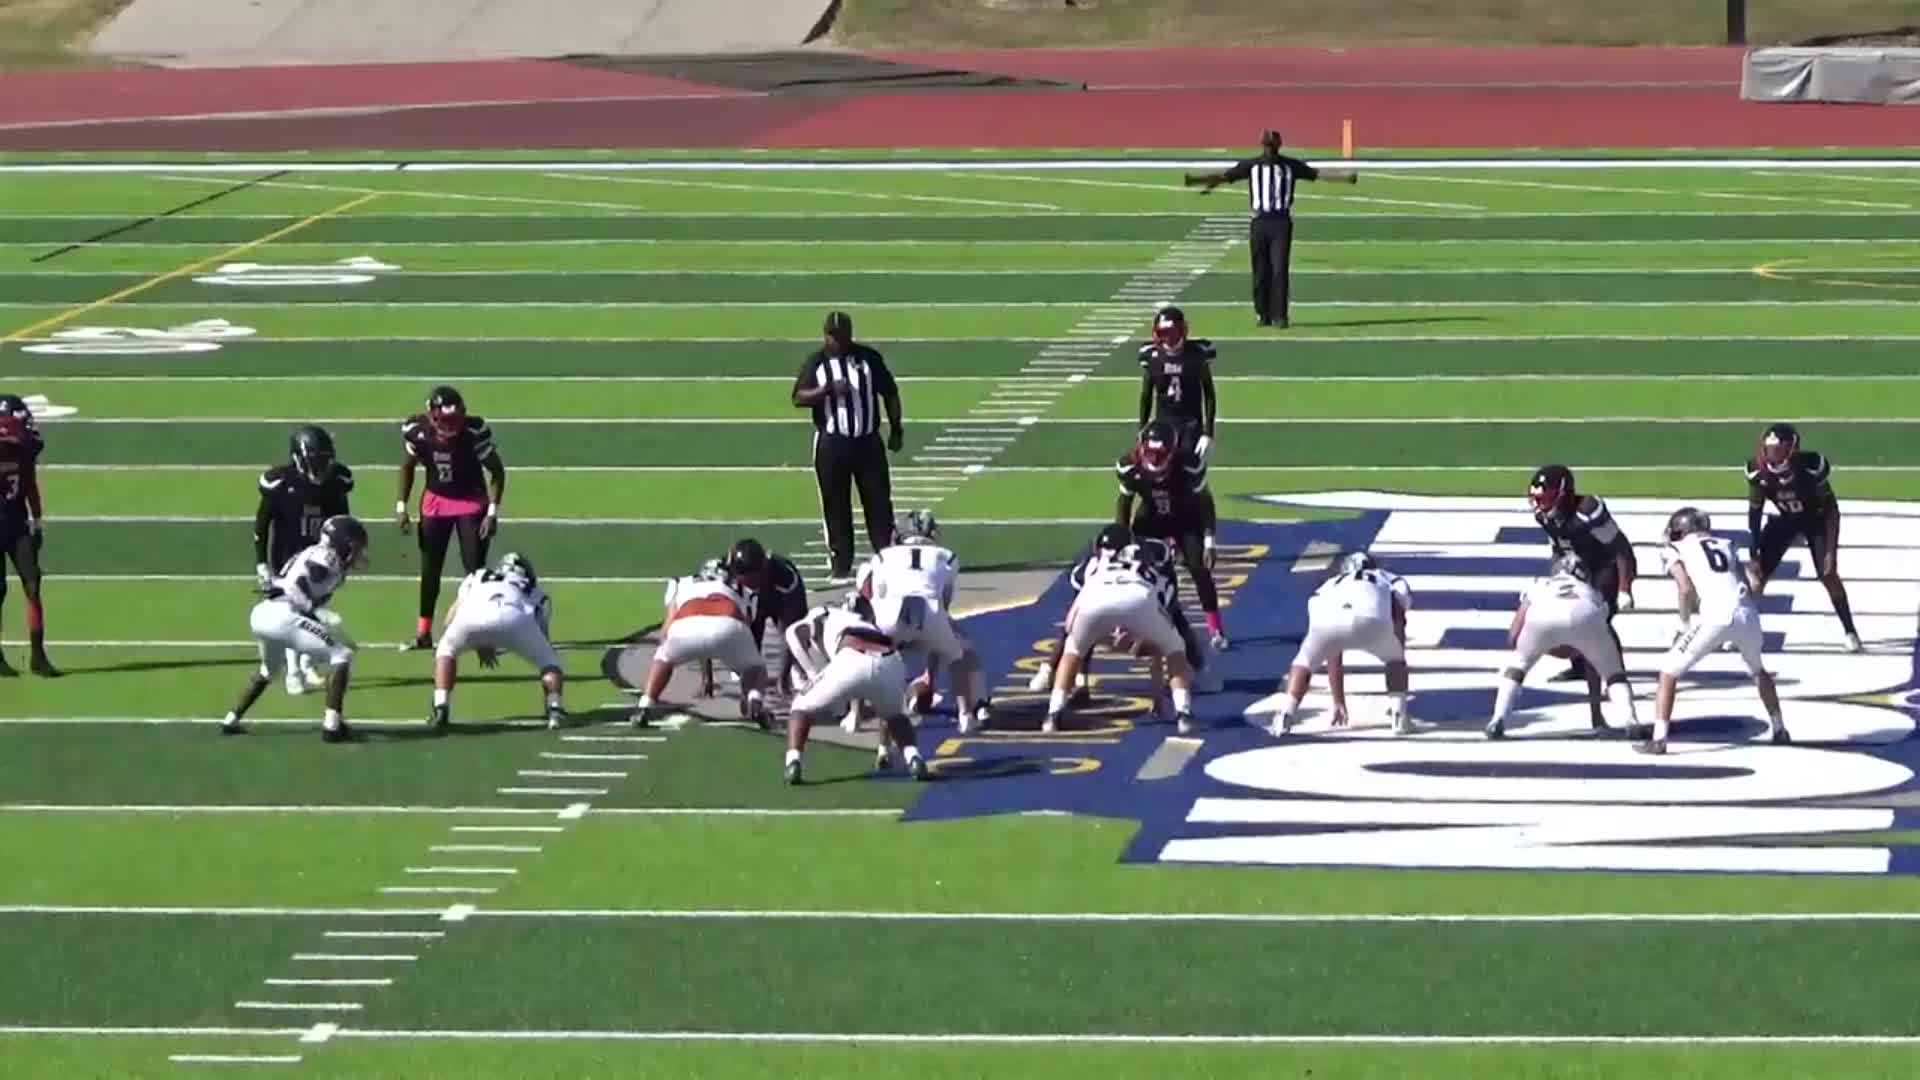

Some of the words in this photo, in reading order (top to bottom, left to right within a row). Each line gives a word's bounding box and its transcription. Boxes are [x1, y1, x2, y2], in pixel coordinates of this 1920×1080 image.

[1166, 376, 1182, 402] 4
[909, 547, 923, 572] 1
[1699, 538, 1729, 573] 6
